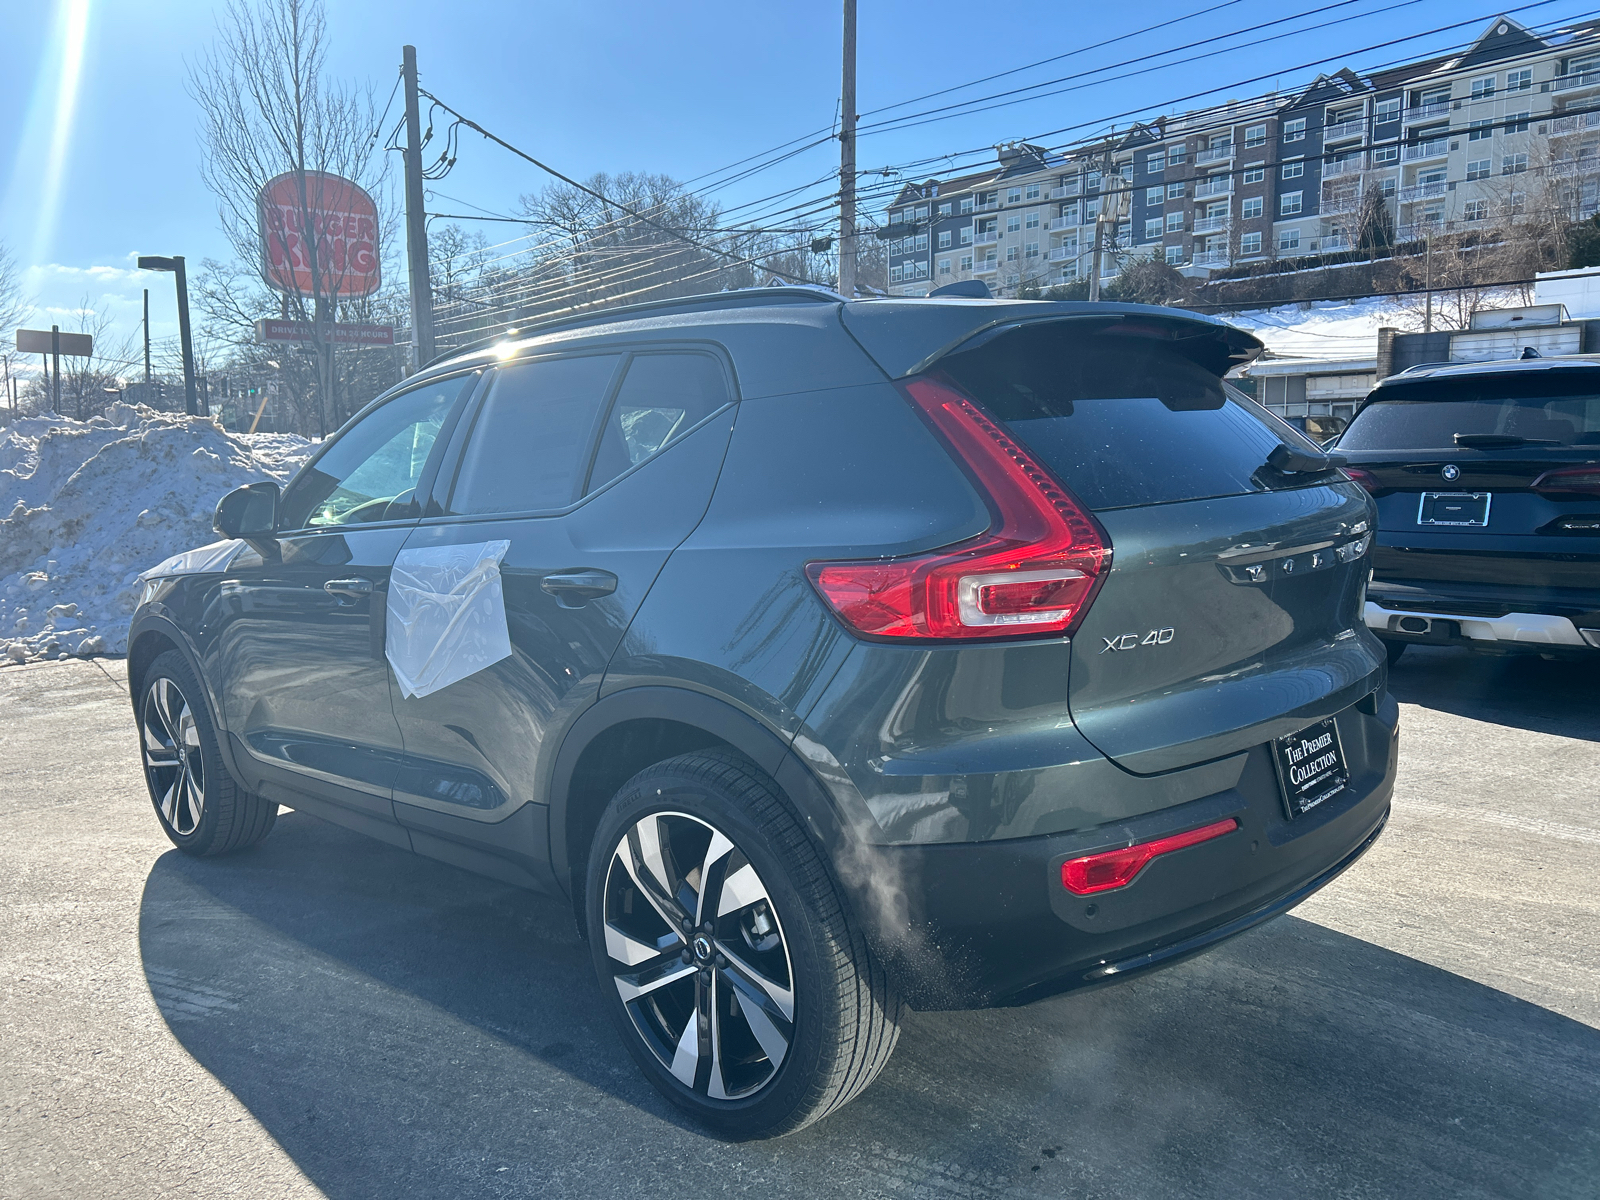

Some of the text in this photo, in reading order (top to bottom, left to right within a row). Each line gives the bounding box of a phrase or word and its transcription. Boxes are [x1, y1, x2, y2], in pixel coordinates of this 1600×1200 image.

[267, 207, 375, 241] BURGER
[268, 231, 376, 274] KING
[348, 330, 359, 338] 24
[360, 330, 389, 339] HOURS
[1245, 540, 1365, 583] VOLVO
[1285, 746, 1304, 766] THE
[1301, 732, 1333, 757] PREMIER
[1290, 750, 1337, 785] COLLECTION
[615, 788, 642, 814] PIRELLI
